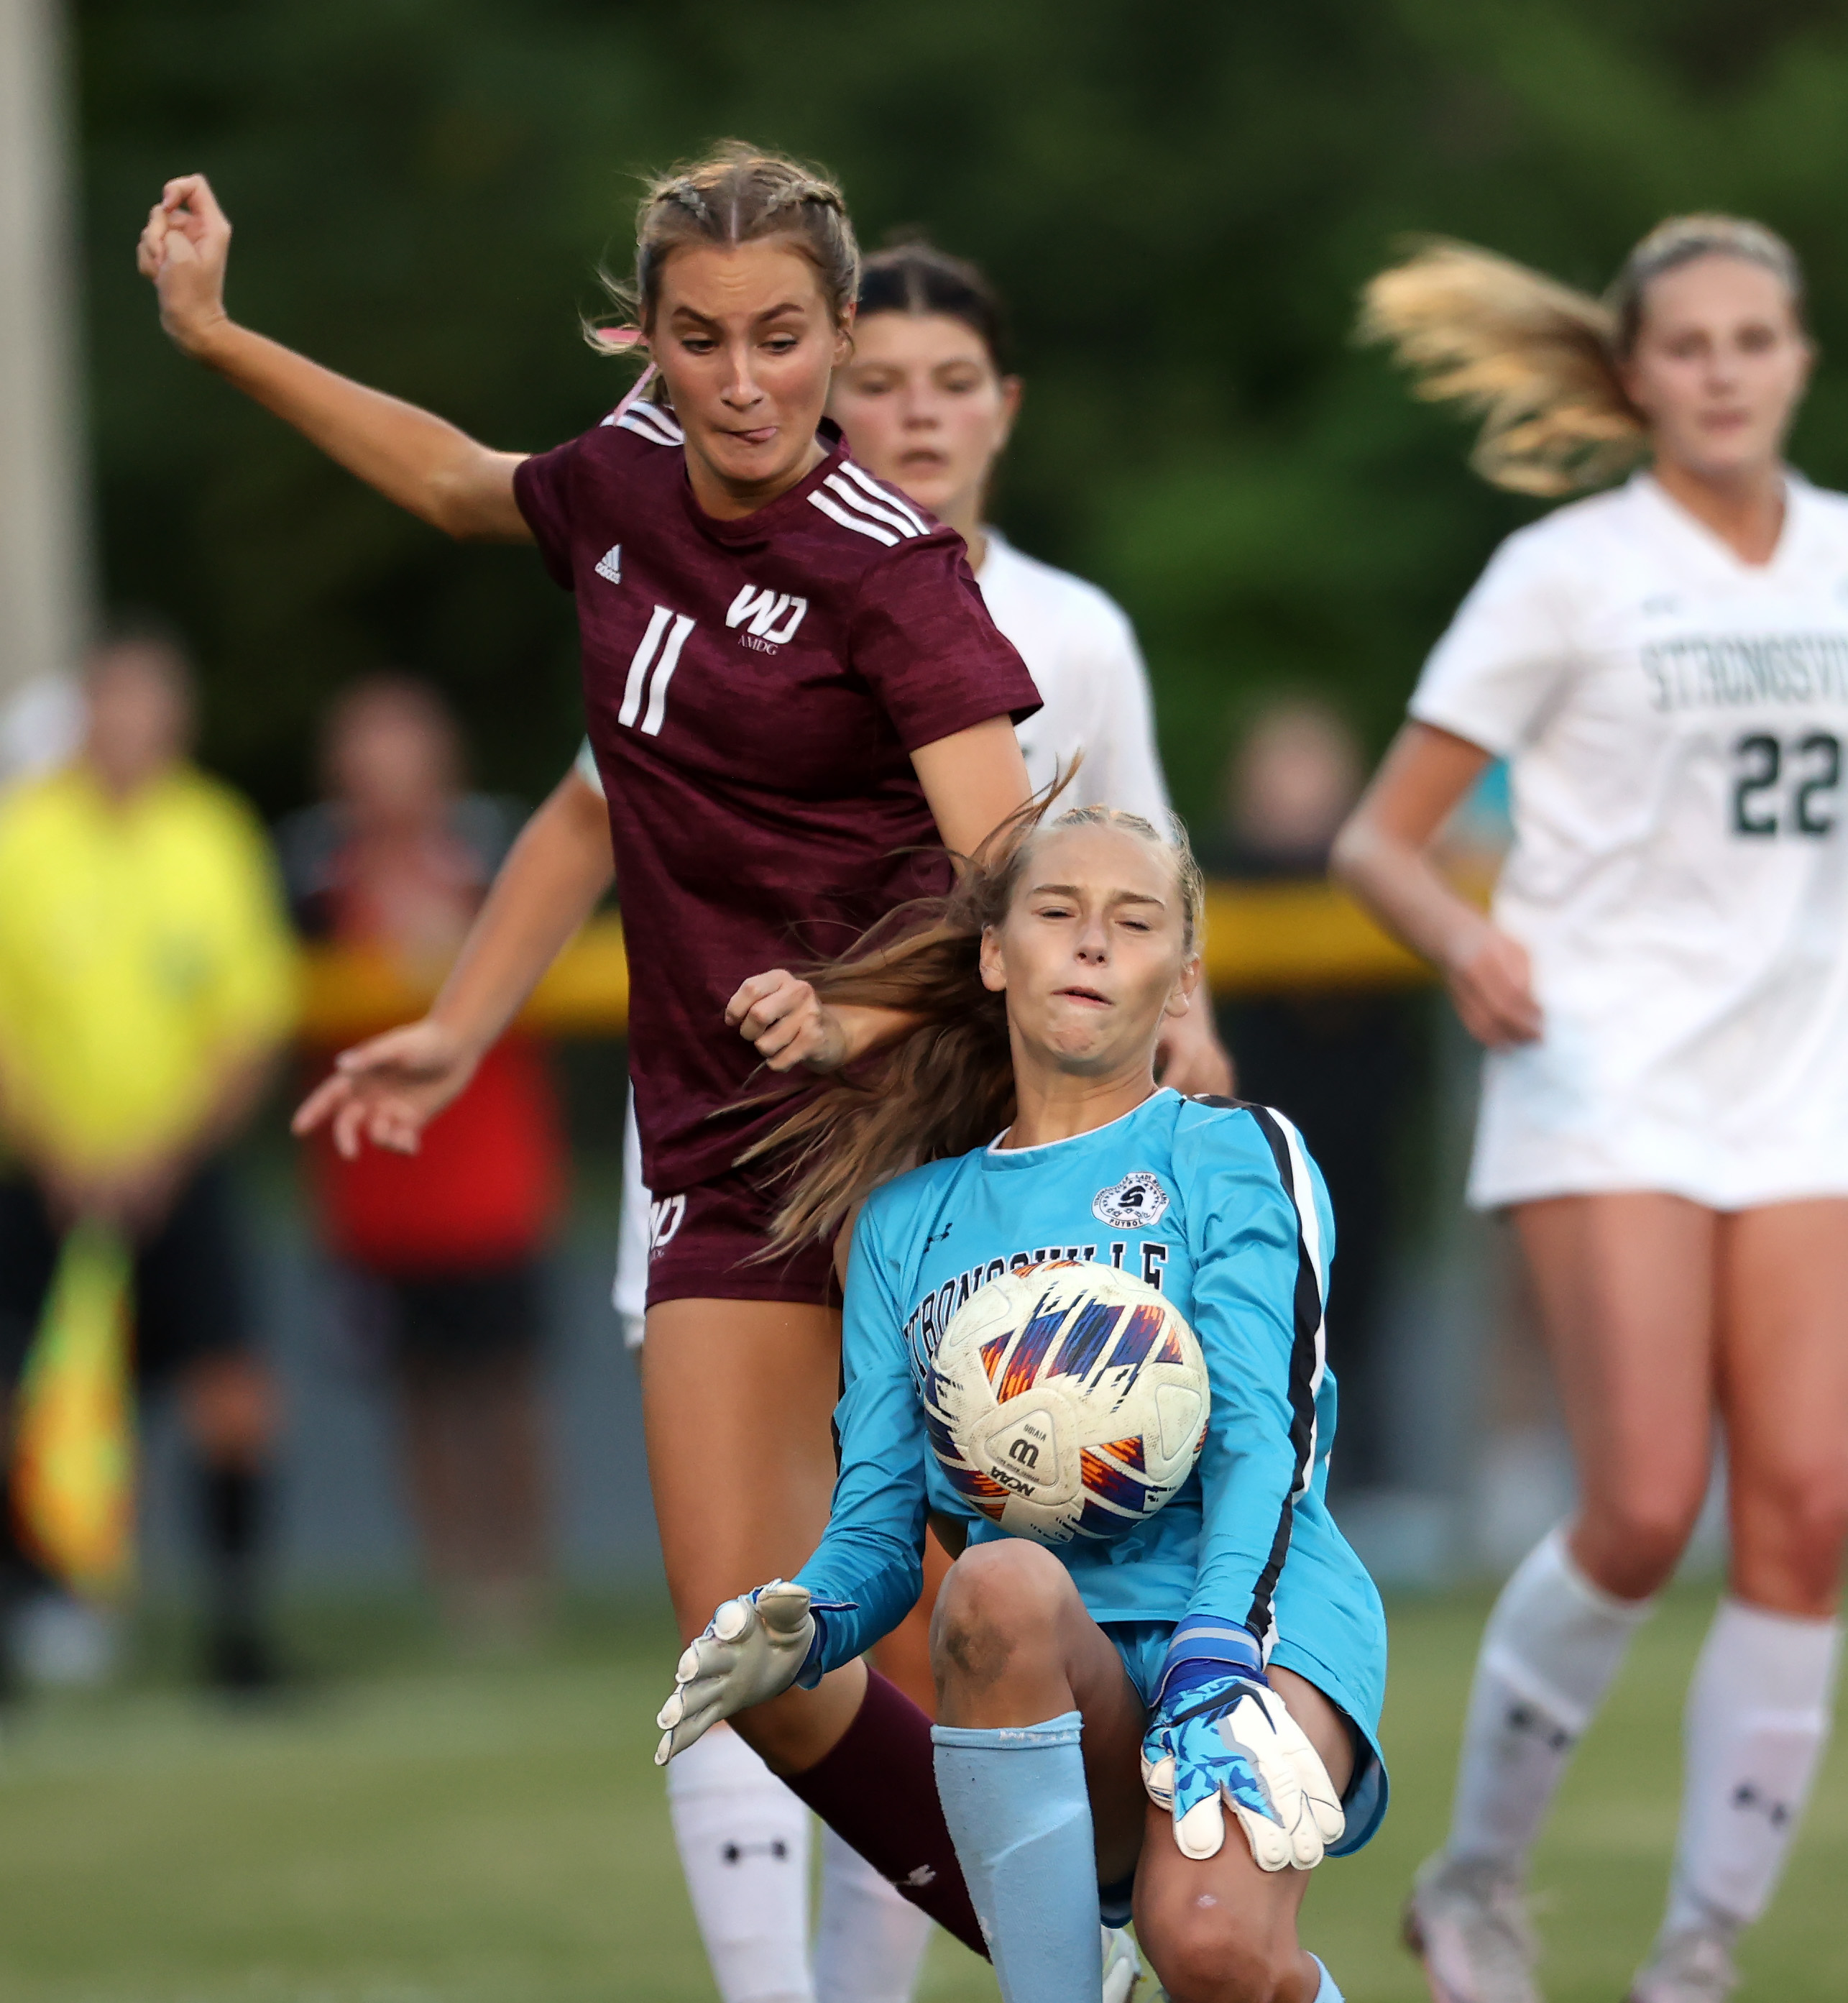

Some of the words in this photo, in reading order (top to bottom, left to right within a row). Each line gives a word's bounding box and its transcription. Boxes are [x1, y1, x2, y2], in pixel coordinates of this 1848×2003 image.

[737, 634, 778, 656] AMDG
[618, 605, 697, 737] 11
[1733, 730, 1839, 836] 22
[1109, 1219, 1144, 1227] FUTBOL
[991, 1466, 1036, 1496] NCAA
